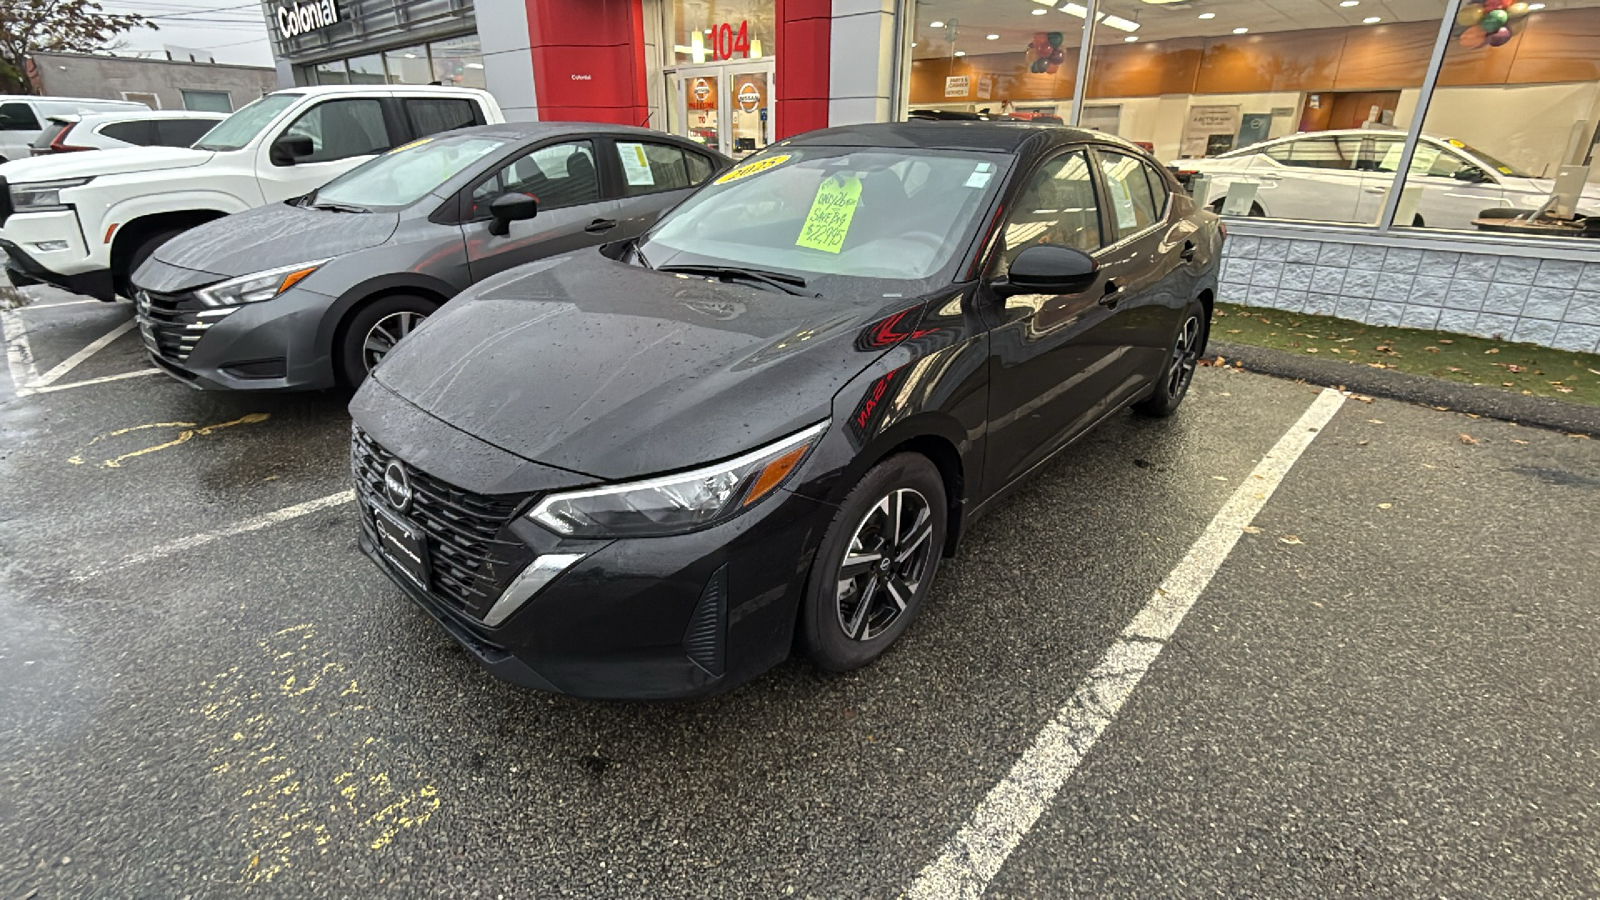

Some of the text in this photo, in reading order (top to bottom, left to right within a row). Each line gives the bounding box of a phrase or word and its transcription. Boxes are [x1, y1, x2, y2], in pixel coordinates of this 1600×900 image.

[278, 0, 338, 39] Colonial
[707, 19, 750, 62] 104
[698, 116, 706, 124] TO
